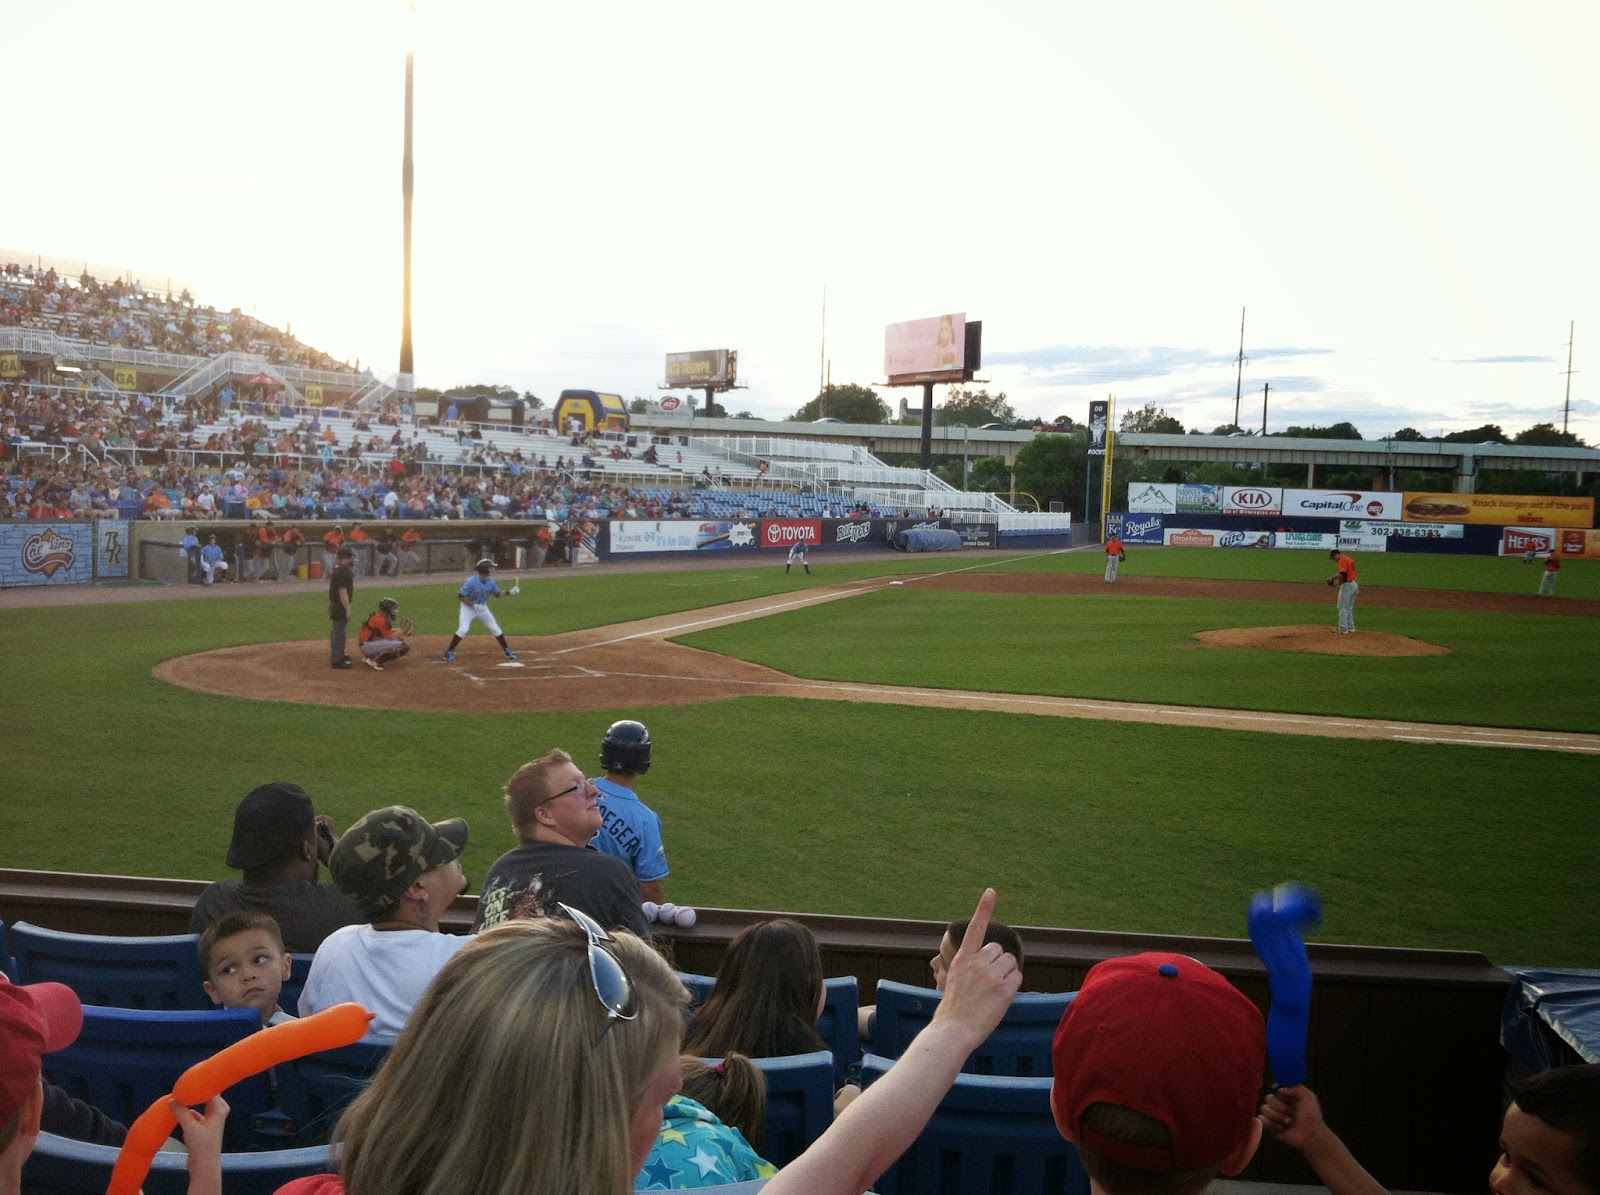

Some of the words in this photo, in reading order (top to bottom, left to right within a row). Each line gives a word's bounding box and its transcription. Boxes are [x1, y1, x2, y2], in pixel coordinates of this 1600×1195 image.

[116, 373, 134, 385] GA
[1238, 493, 1265, 504] KIA
[1472, 499, 1497, 507] Knock
[1499, 501, 1528, 510] hunger
[781, 526, 815, 540] TOYOTA
[1125, 517, 1161, 537] Royals
[1335, 535, 1361, 548] TANGENT
[22, 533, 74, 570] Catlina
[484, 897, 505, 918] ON
